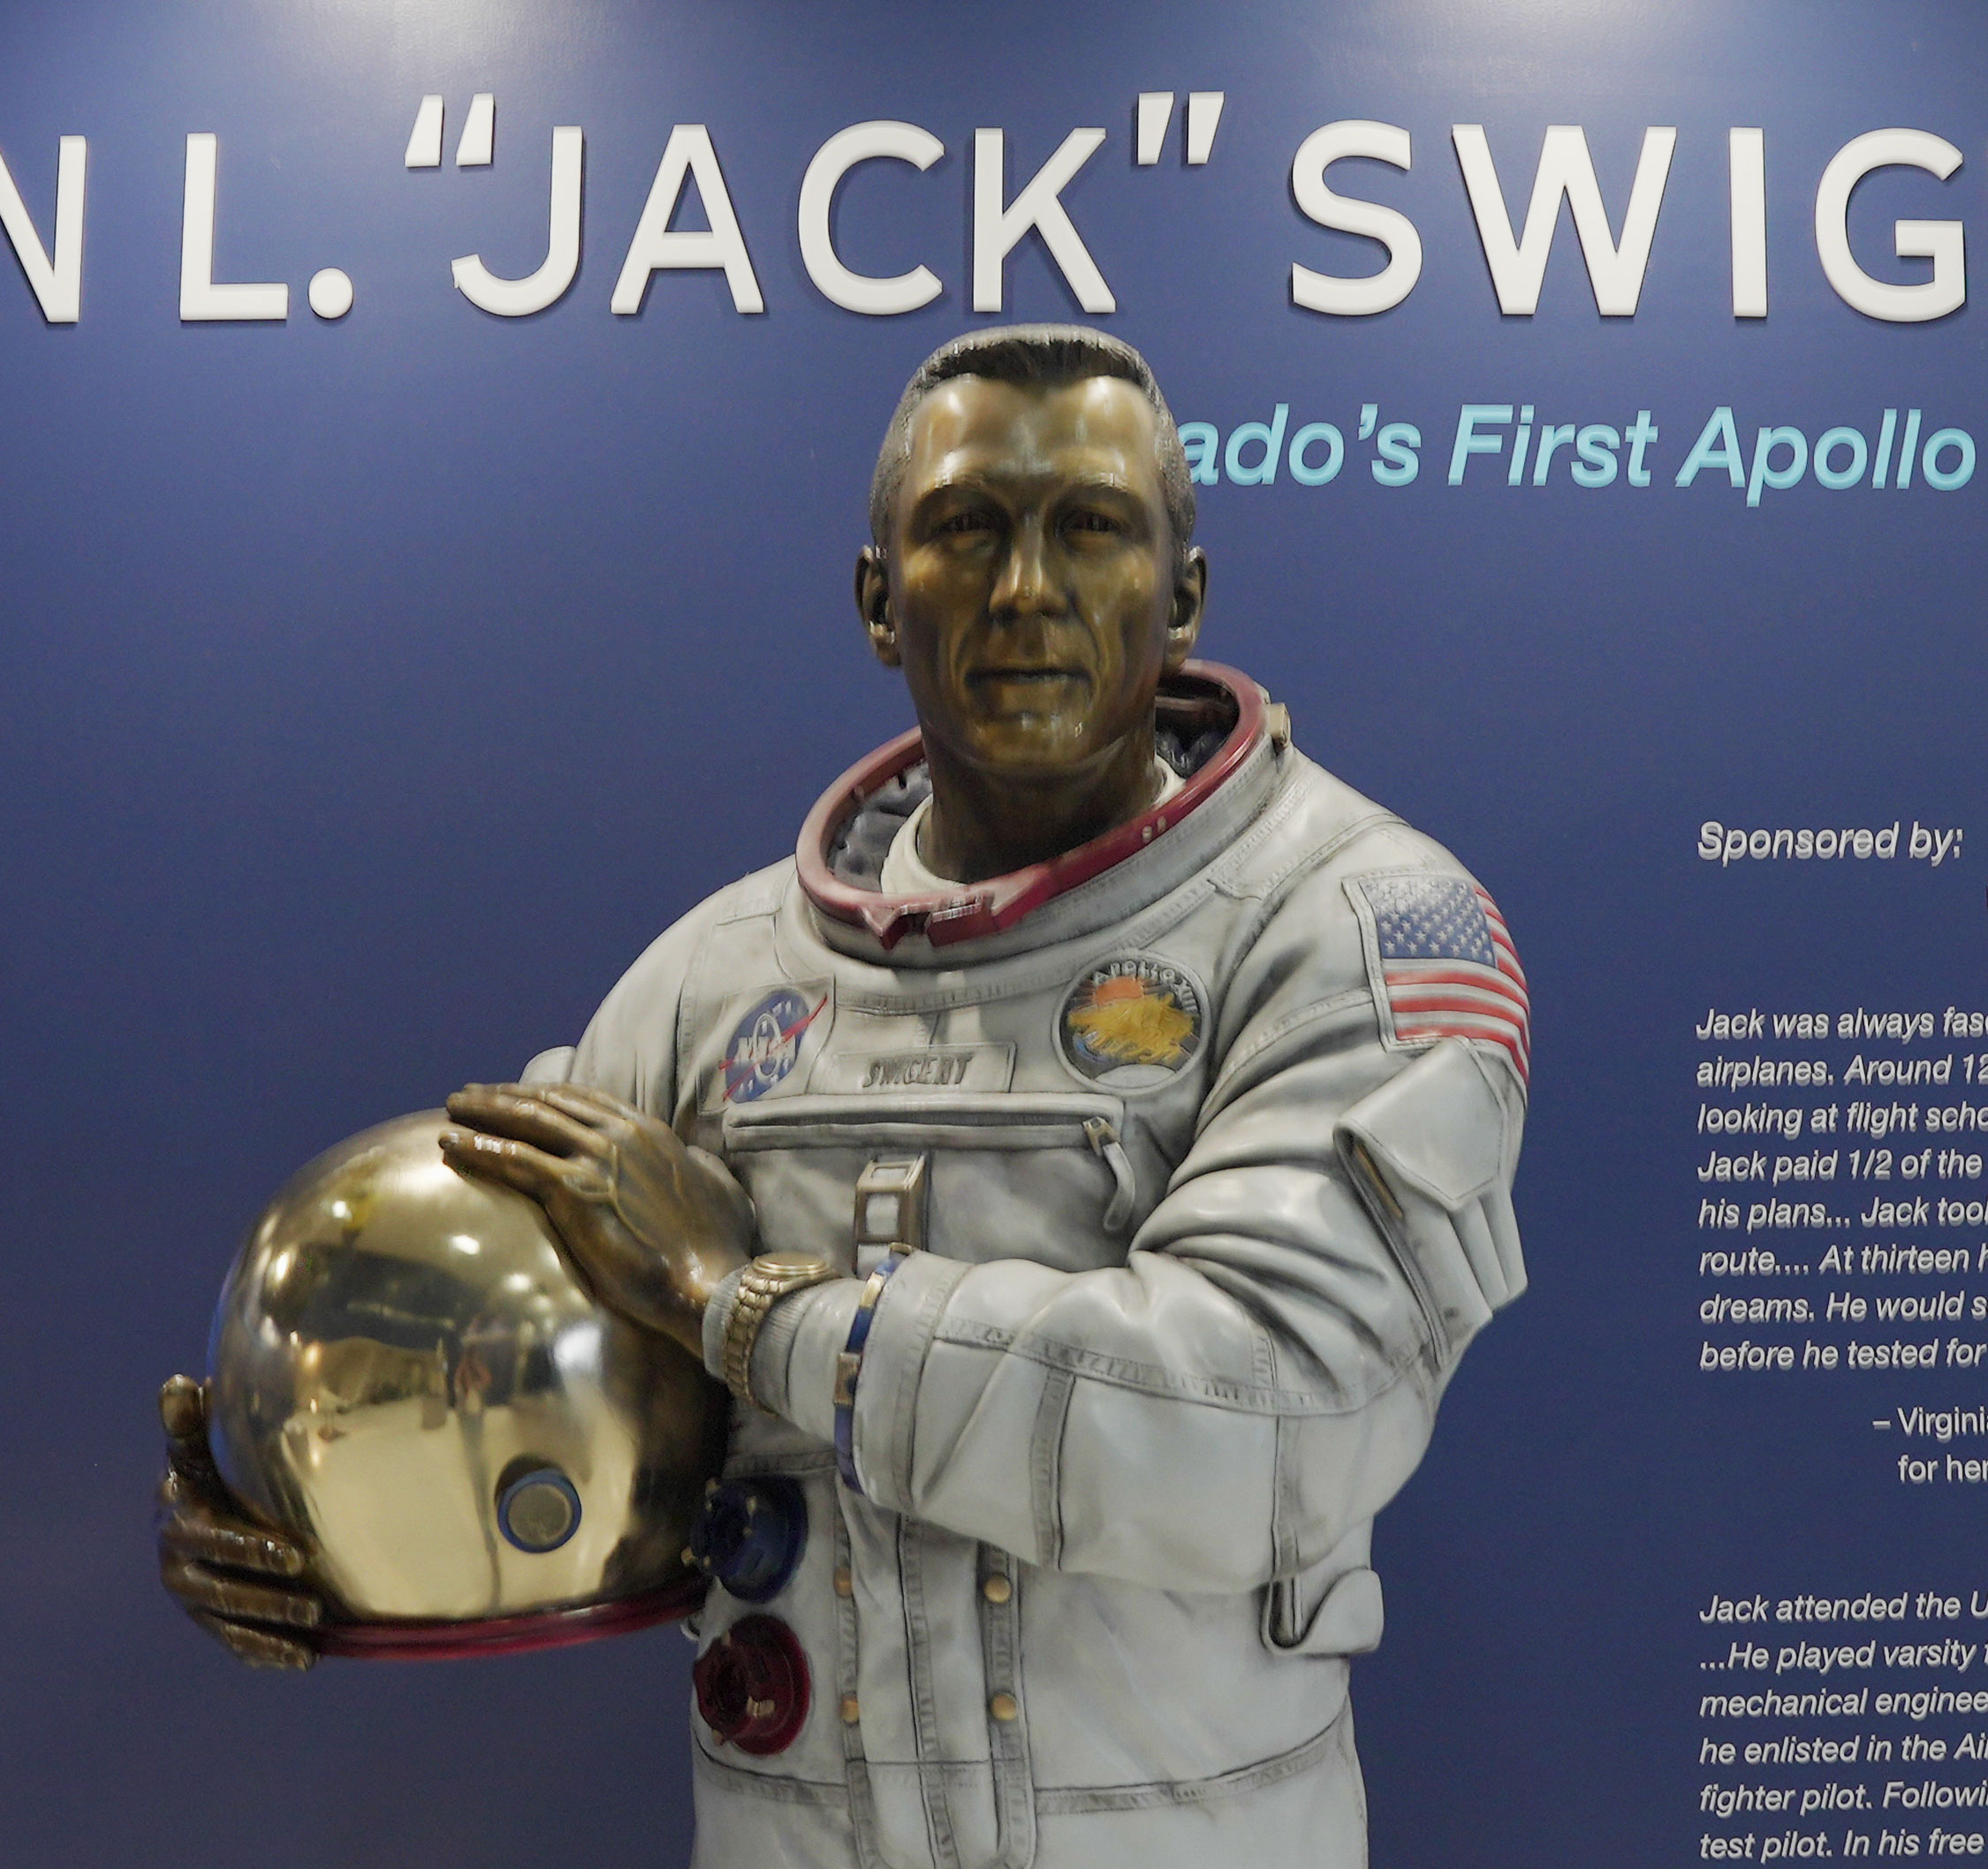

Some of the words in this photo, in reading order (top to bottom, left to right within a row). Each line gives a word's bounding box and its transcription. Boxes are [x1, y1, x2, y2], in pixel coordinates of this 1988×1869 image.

[180, 133, 353, 321] L.
[1292, 118, 1967, 322] SWIG
[1448, 404, 1658, 488] First
[1675, 406, 1977, 507] Apollo
[1697, 821, 1900, 868] Sponsored
[1909, 821, 1963, 867] by:
[1696, 1007, 1765, 1040] Jack
[1772, 1013, 1830, 1039] was
[1838, 1007, 1935, 1045] always
[1944, 1007, 1988, 1038] fas
[1696, 1056, 1834, 1092] airplanes.
[1843, 1054, 1953, 1085] Around
[1698, 1103, 1803, 1140] looking
[1810, 1104, 1839, 1133] at
[1848, 1102, 1919, 1139] flight
[1697, 1151, 1767, 1182] Jack
[1772, 1150, 1839, 1187] paid
[1848, 1149, 1893, 1180] 1/2
[1901, 1149, 1932, 1180] of
[1938, 1149, 1983, 1180] the
[1699, 1198, 1741, 1229] his
[1746, 1197, 1850, 1235] plans...
[1861, 1197, 1930, 1227] Jack
[1938, 1197, 1988, 1227] too
[1700, 1246, 1810, 1276] route....
[1818, 1245, 1855, 1274] At
[1862, 1243, 1969, 1274] thirteen
[1700, 1293, 1815, 1324] dreams.
[1826, 1292, 1868, 1322] He
[1876, 1290, 1965, 1321] would
[1700, 1341, 1795, 1371] before
[1802, 1340, 1839, 1369] he
[1848, 1338, 1939, 1369] tested
[1946, 1338, 1988, 1368] for
[1897, 1406, 1988, 1442] Virgini
[1898, 1455, 1939, 1483] for
[1700, 1594, 1770, 1623] Jack
[1776, 1592, 1908, 1622] attended
[1916, 1592, 1961, 1620] the
[1775, 1640, 1877, 1675] played
[1884, 1638, 1977, 1673] varsity
[1700, 1688, 1869, 1717] mechanical
[1700, 1737, 1736, 1765] he
[1744, 1735, 1860, 1764] enlisted
[1867, 1735, 1893, 1761] in
[1901, 1734, 1947, 1761] the
[1954, 1732, 1988, 1760] Ai
[1700, 1783, 1796, 1819] fighter
[1800, 1782, 1872, 1816] pilot.
[1882, 1780, 1988, 1809] Followi
[1700, 1833, 1756, 1859] test
[1760, 1830, 1832, 1865] pilot.
[1843, 1830, 1870, 1857] In
[1878, 1828, 1921, 1856] his
[1929, 1827, 1984, 1855] free
